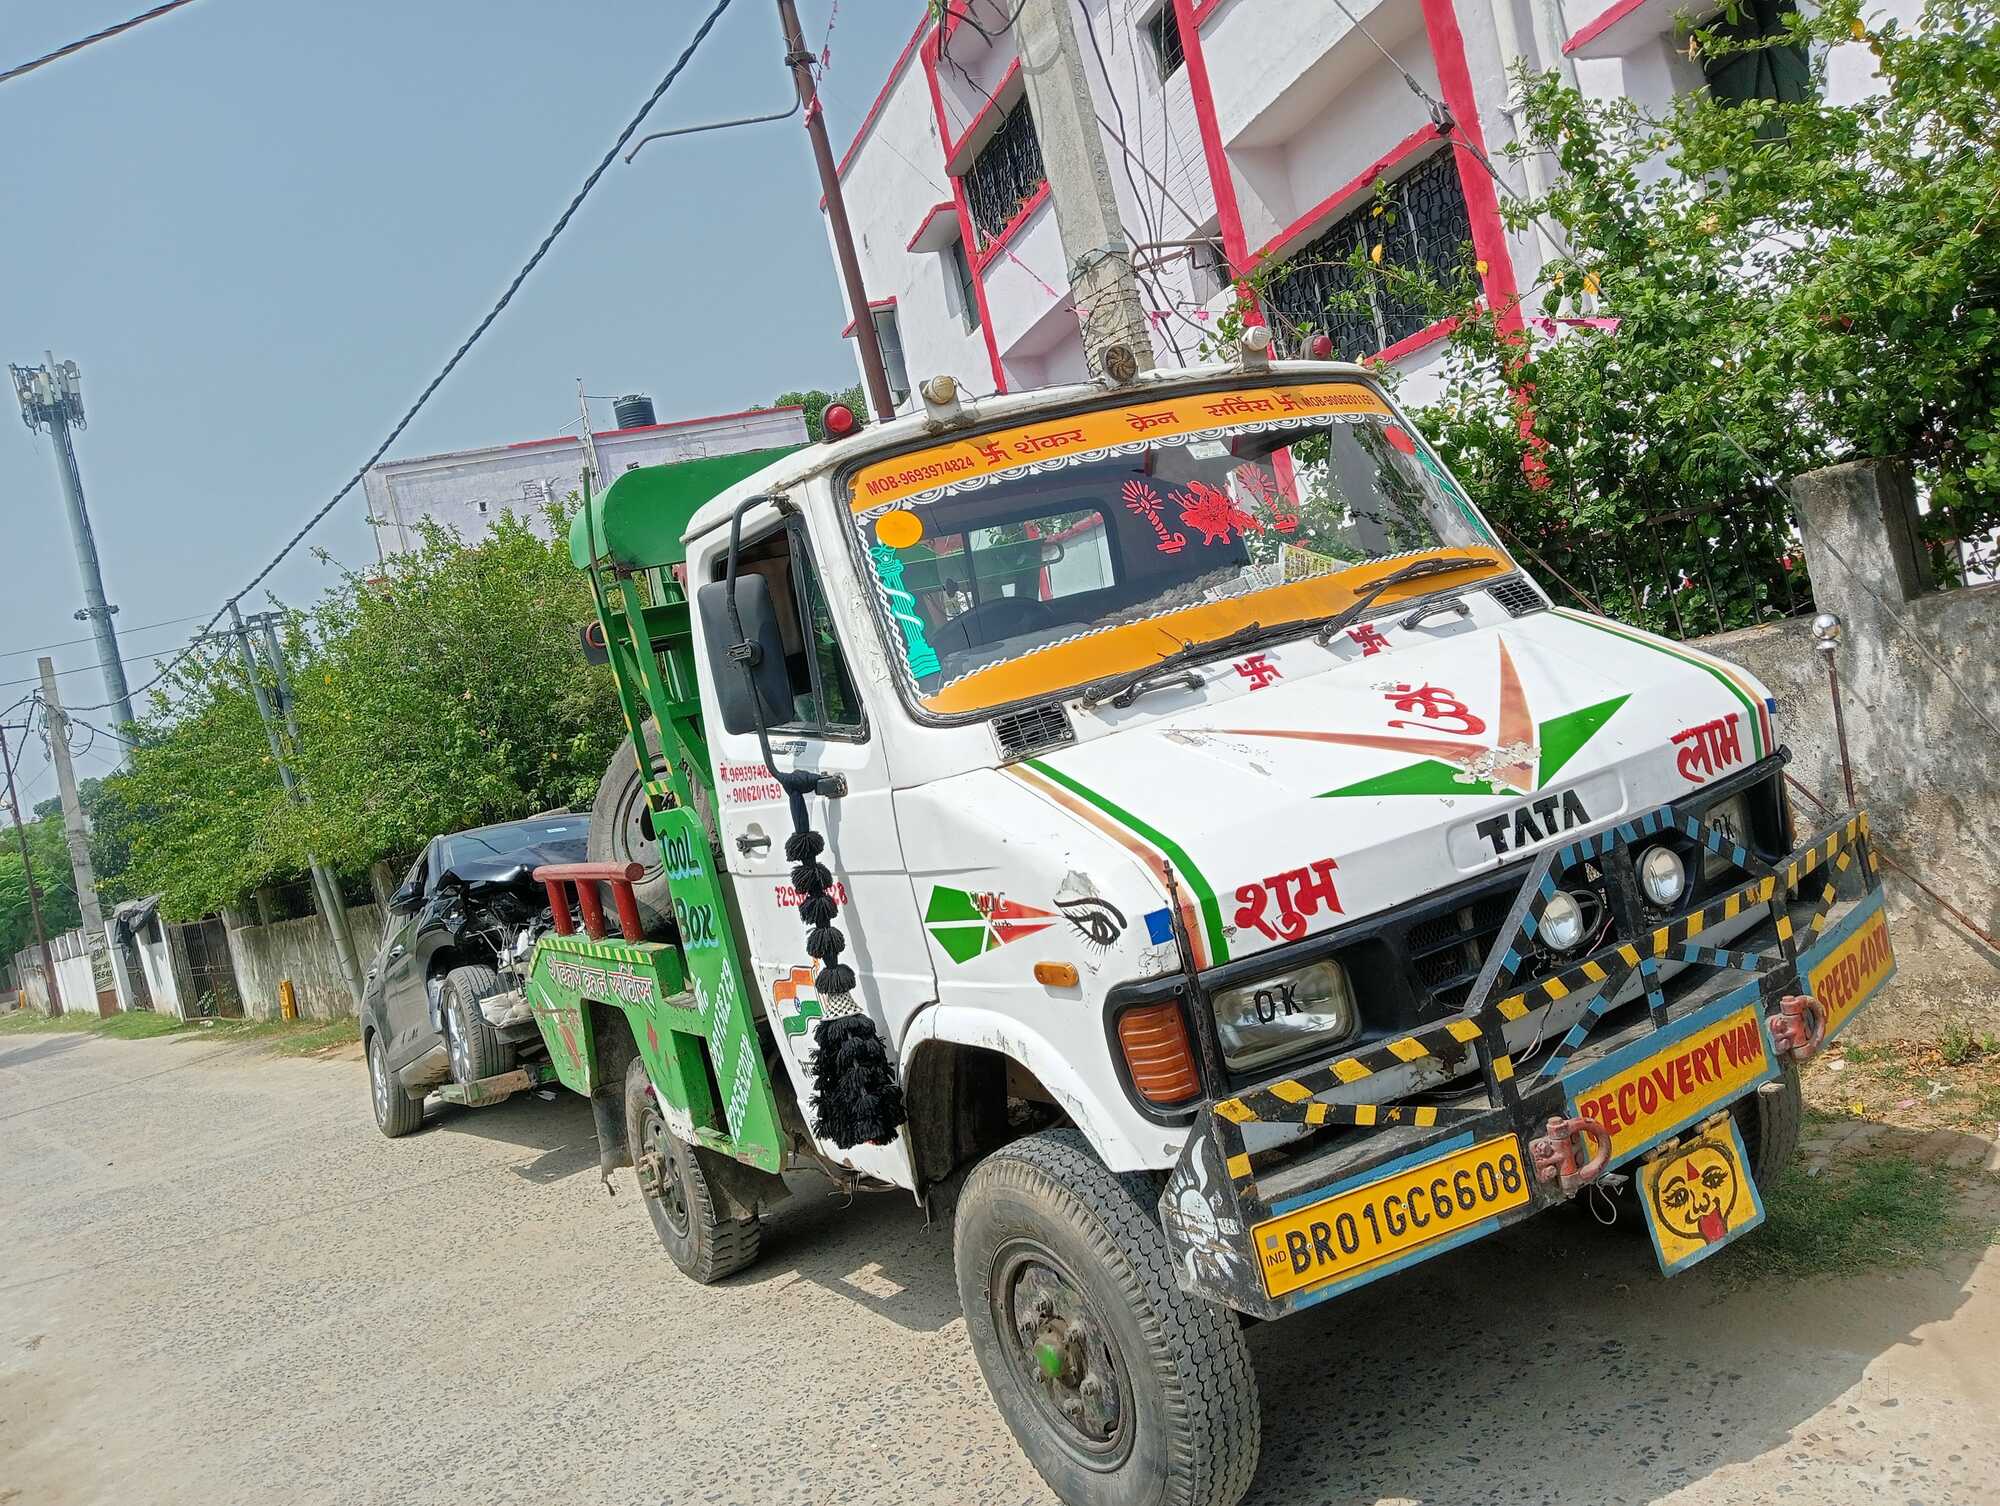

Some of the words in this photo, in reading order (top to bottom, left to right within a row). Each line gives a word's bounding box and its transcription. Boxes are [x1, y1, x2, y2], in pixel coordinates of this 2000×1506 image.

[1014, 429, 1087, 456] शंकर
[1126, 411, 1180, 432] क्रेन
[1202, 395, 1275, 417] सर्विस
[866, 455, 975, 496] MOB-9693974824
[1669, 712, 1743, 784] लाभ
[1475, 788, 1591, 855] TATA
[1233, 857, 1346, 942] शुभ
[1285, 1153, 1522, 1276] BR01GC6608
[1265, 1250, 1287, 1268] IND
